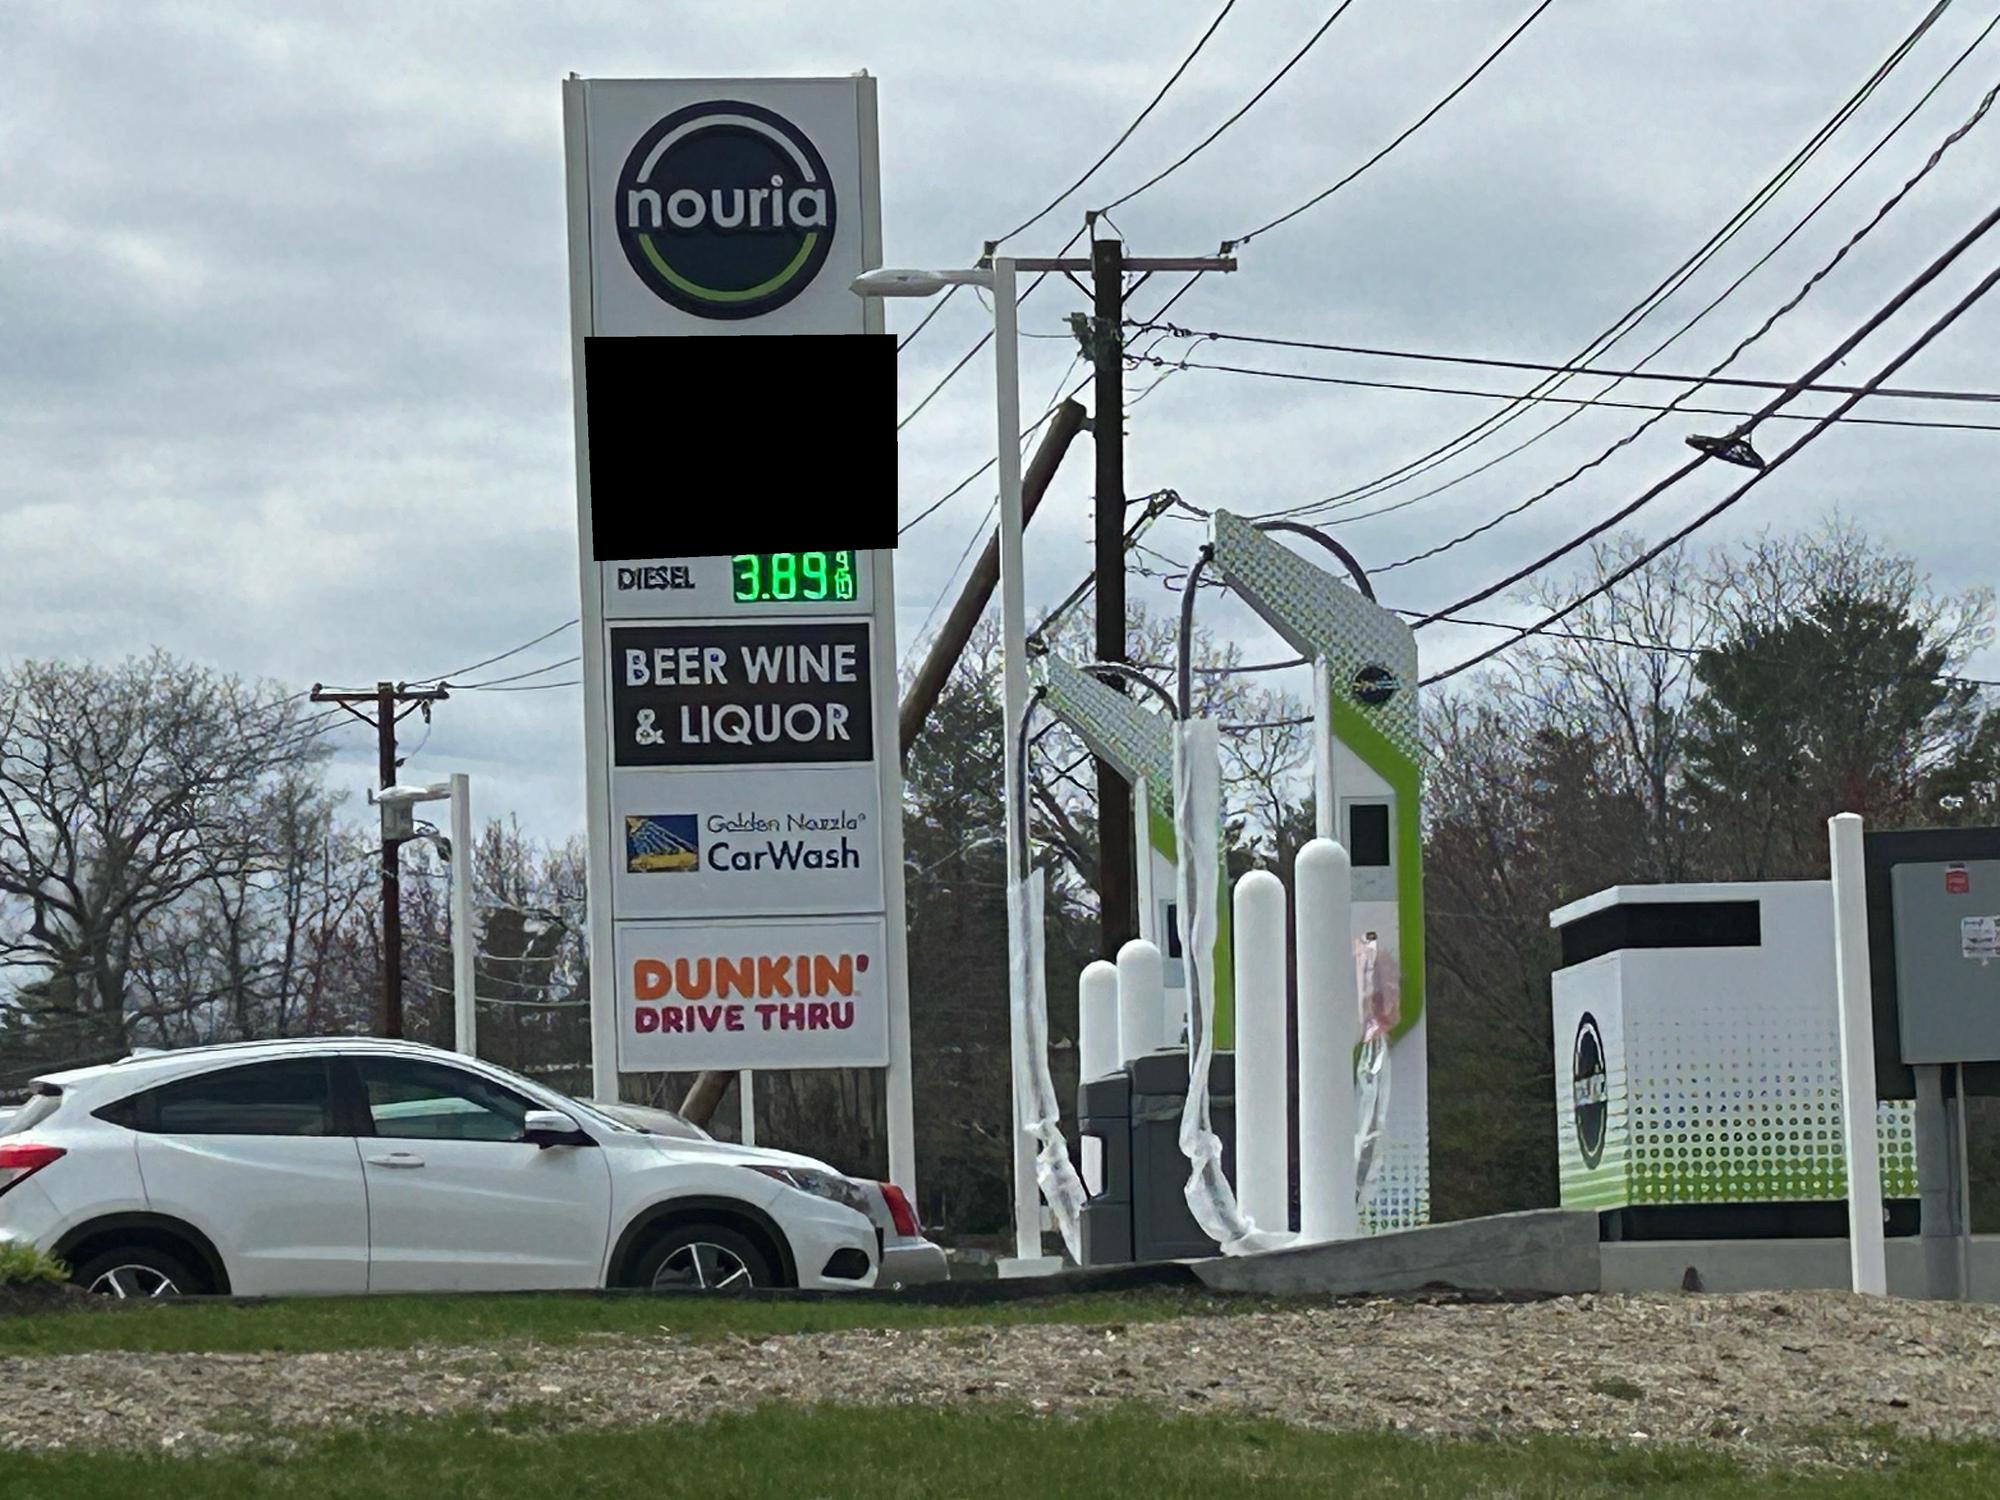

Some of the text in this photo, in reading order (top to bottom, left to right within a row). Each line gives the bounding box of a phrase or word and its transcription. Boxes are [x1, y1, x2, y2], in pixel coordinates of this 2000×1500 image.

[628, 174, 827, 228] nouria
[618, 566, 696, 590] DIESEL
[732, 552, 827, 600] 3.89
[626, 644, 857, 686] BEER WINE
[635, 703, 850, 745] & LIQUOR
[707, 811, 780, 833] Golden
[707, 836, 860, 871] CarWash
[633, 954, 869, 1000] DUNKIN'
[634, 1001, 855, 1034] DRIVE THRU
